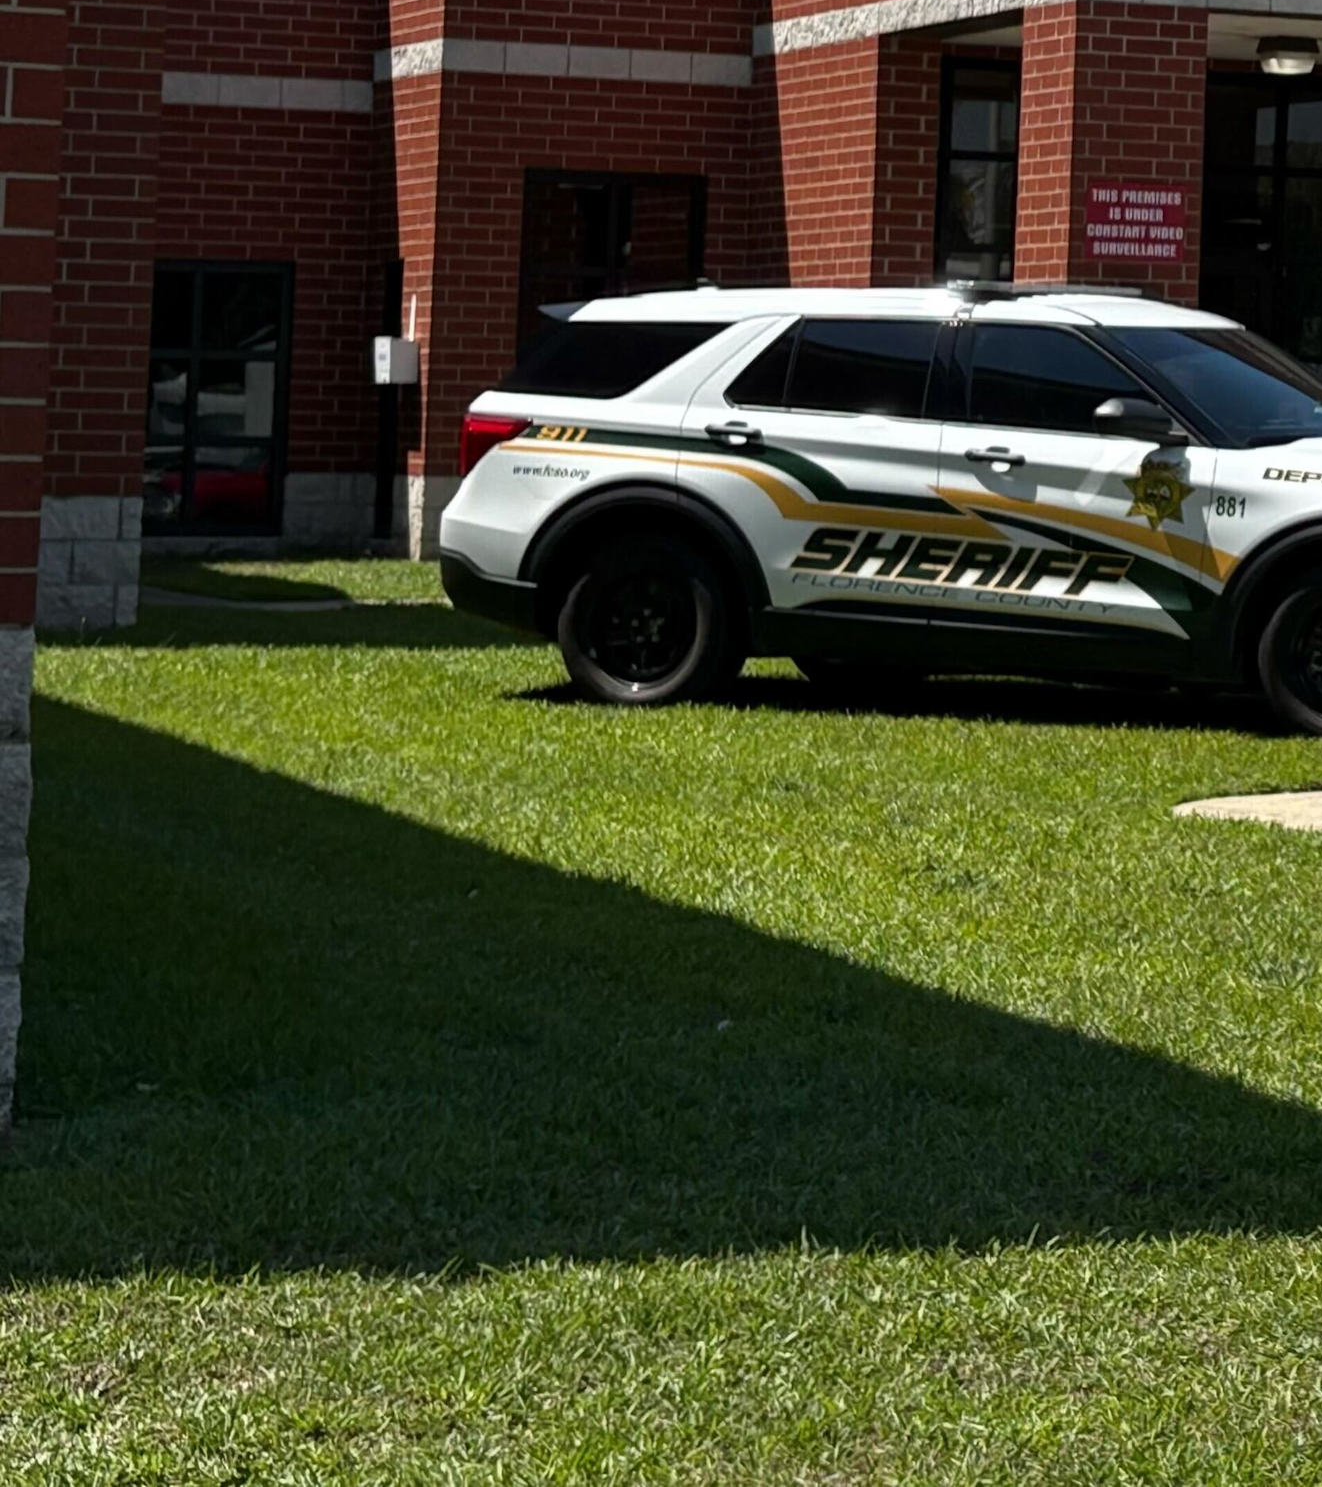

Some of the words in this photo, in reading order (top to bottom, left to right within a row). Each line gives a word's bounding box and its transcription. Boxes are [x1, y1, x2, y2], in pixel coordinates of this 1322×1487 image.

[1092, 188, 1119, 204] THIS
[1122, 189, 1182, 206] PREMISES
[1109, 207, 1121, 220] IS
[1125, 207, 1164, 222] UNDER
[1087, 223, 1146, 239] CONSTANT
[1150, 225, 1184, 241] VIDEO
[1092, 241, 1177, 258] SURVEILLANCE
[535, 424, 589, 443] 911
[512, 464, 591, 482] www.fcso.org
[1215, 495, 1247, 519] 881
[787, 526, 1135, 598] SHERIFF
[791, 571, 960, 601] FLORENCE
[974, 590, 1124, 614] COUNTY
